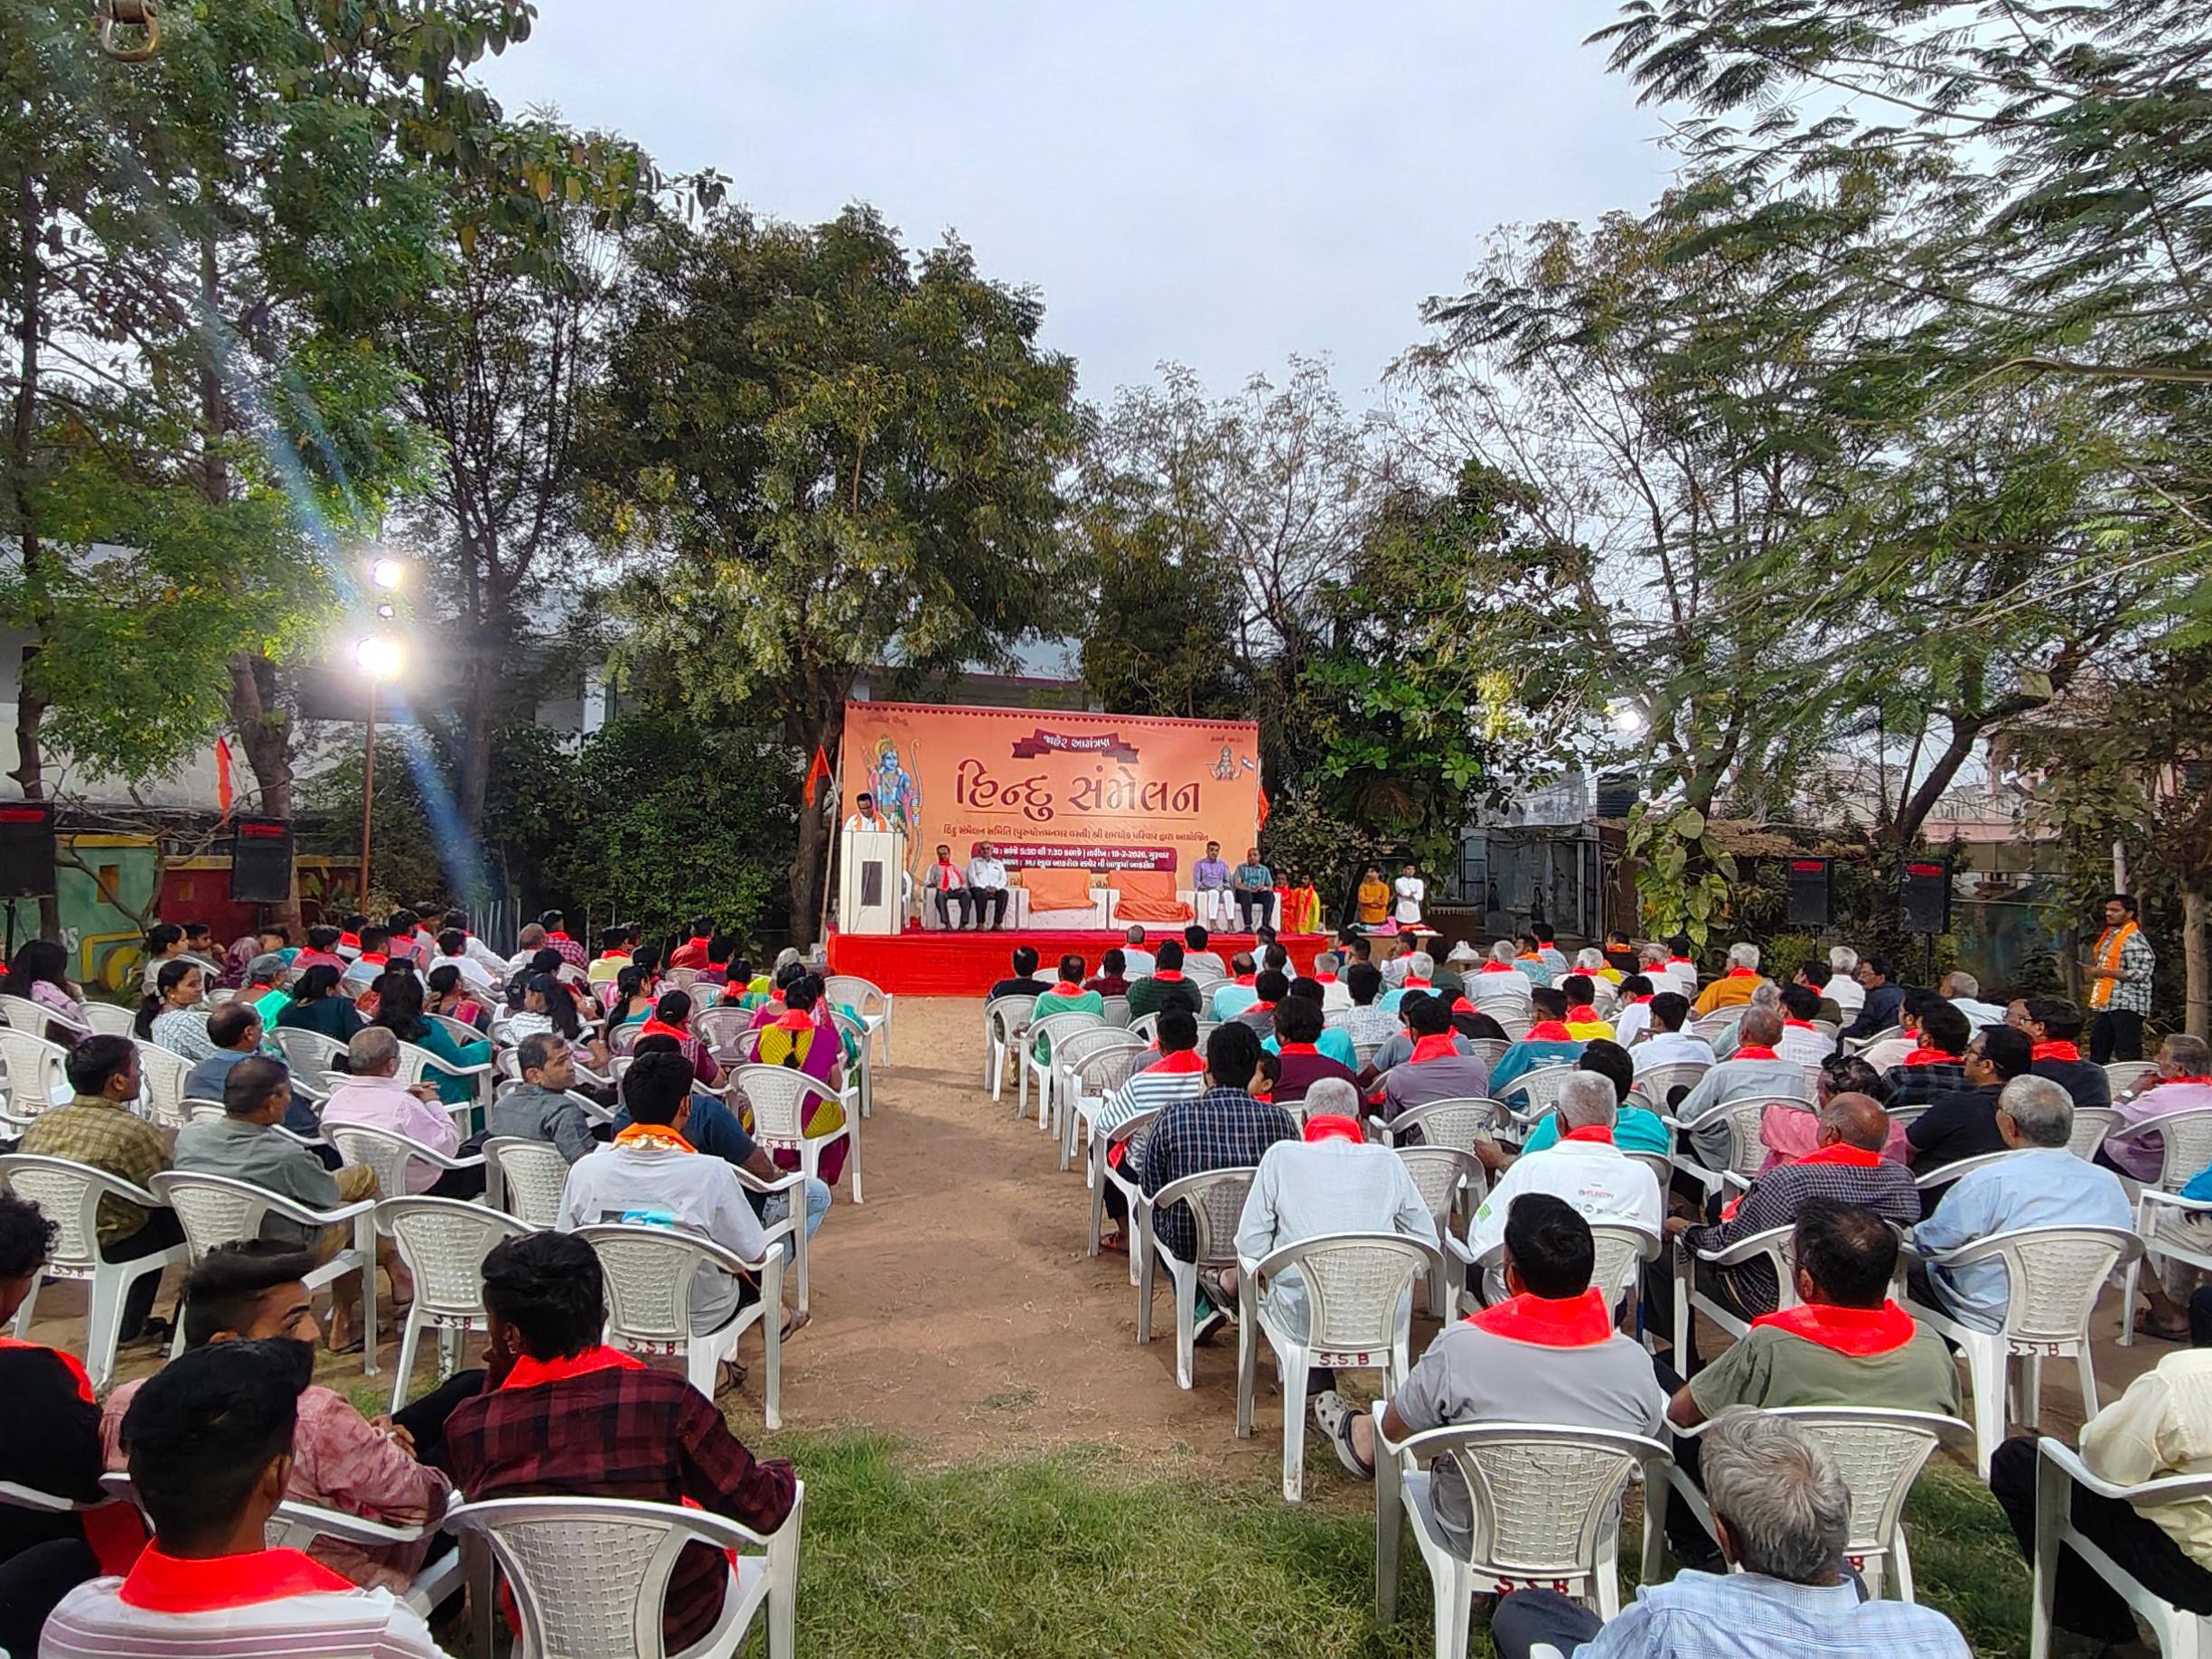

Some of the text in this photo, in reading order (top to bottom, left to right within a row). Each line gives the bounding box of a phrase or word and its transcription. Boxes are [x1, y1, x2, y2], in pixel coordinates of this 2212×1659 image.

[1043, 734, 1111, 749] જાહેર આમંત્રણ
[957, 758, 1200, 821] હિન્દુ સંમેલન
[1318, 1352, 1370, 1366] S.S.B
